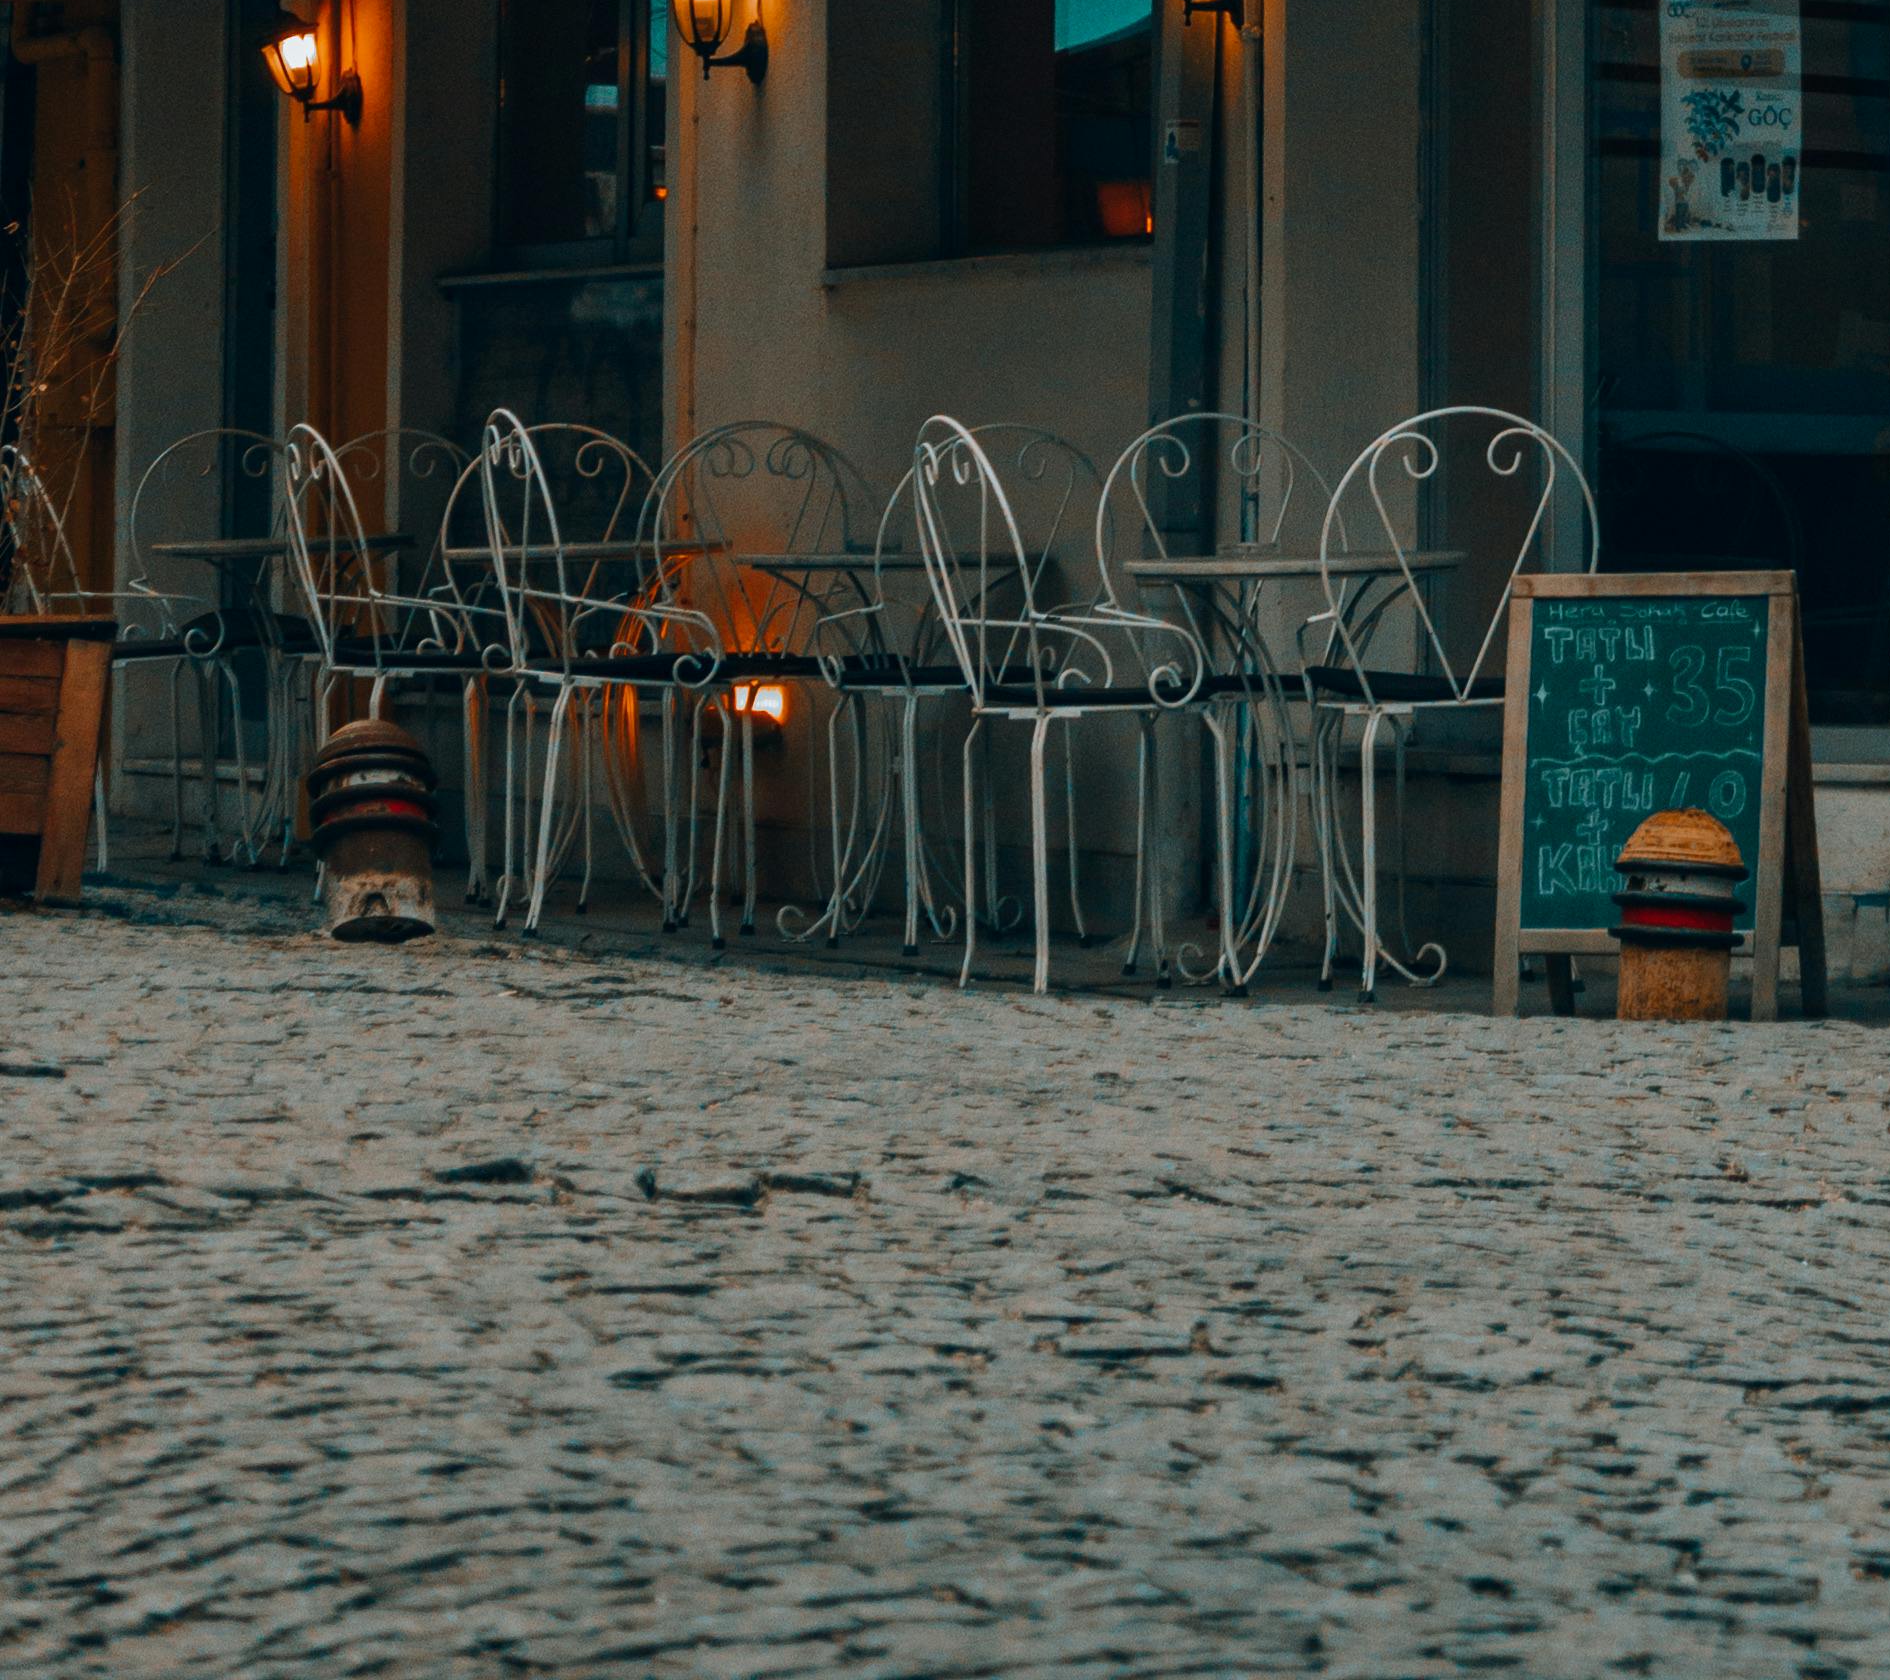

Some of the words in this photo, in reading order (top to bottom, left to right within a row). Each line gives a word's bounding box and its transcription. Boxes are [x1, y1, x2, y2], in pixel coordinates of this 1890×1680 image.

[1544, 625, 1655, 664] TATLI
[1666, 645, 1757, 727] 35
[1541, 767, 1654, 810] TATLI
[1538, 842, 1629, 896] KAH
